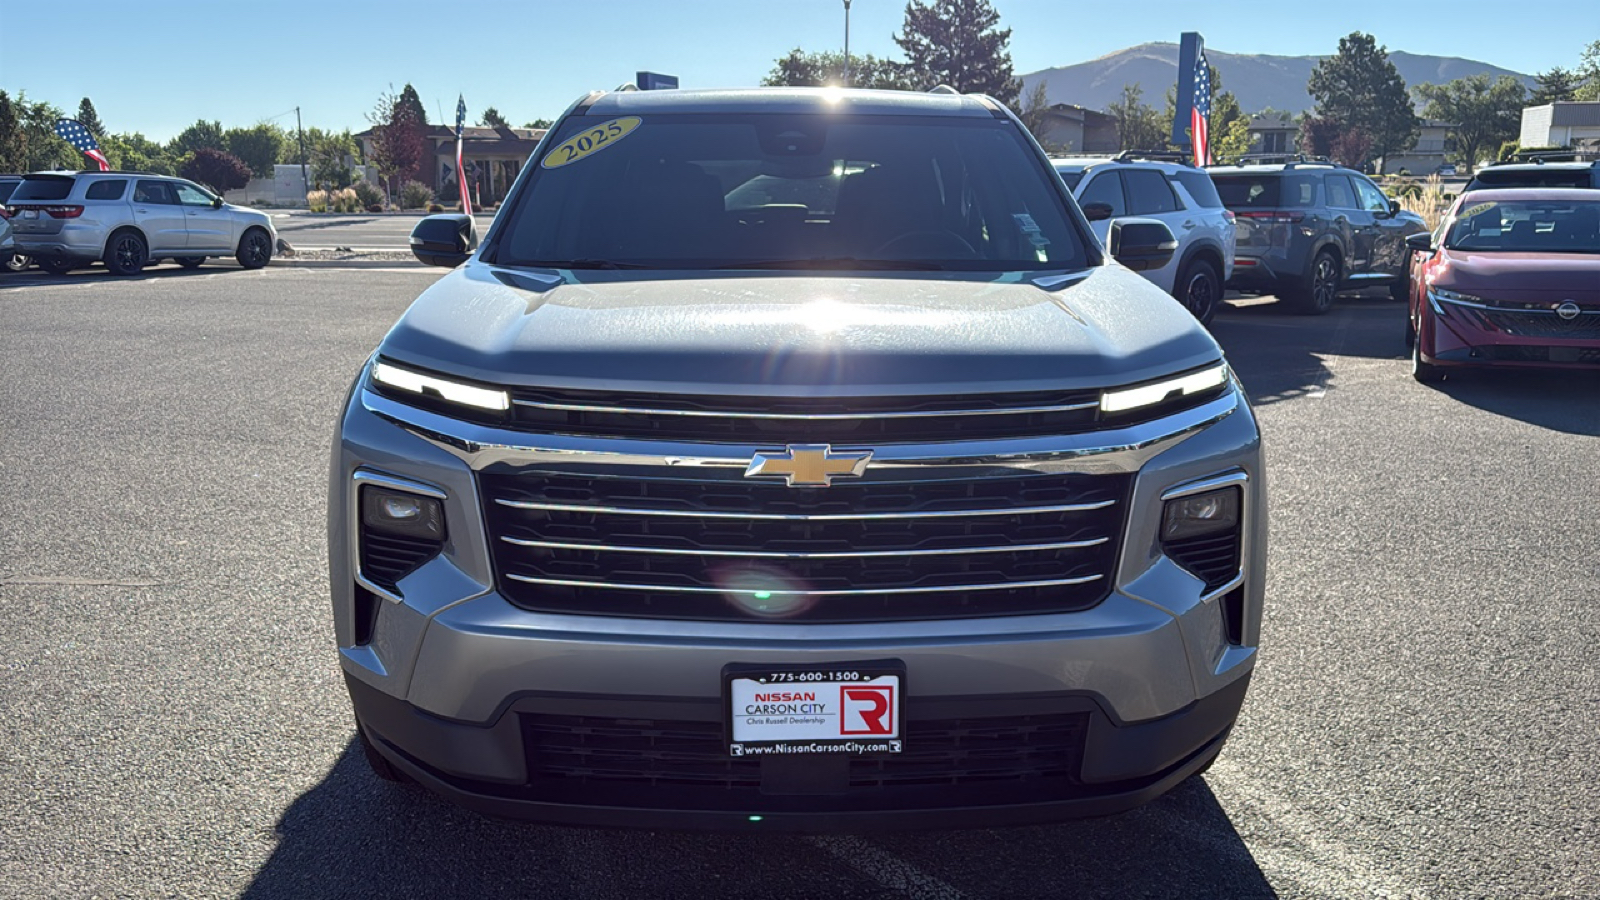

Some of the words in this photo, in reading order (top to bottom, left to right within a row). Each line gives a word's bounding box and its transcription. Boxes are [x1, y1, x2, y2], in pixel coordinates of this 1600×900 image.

[561, 121, 622, 161] 2025
[770, 671, 859, 681] 775-600-1500
[755, 692, 815, 702] NISSAN
[745, 704, 797, 715] CARSON
[800, 703, 826, 714] CITY
[746, 717, 764, 725] Chris
[765, 716, 788, 725] Russell
[789, 716, 825, 725] Dealership
[745, 742, 887, 754] www.NissanCarsonCity.com
